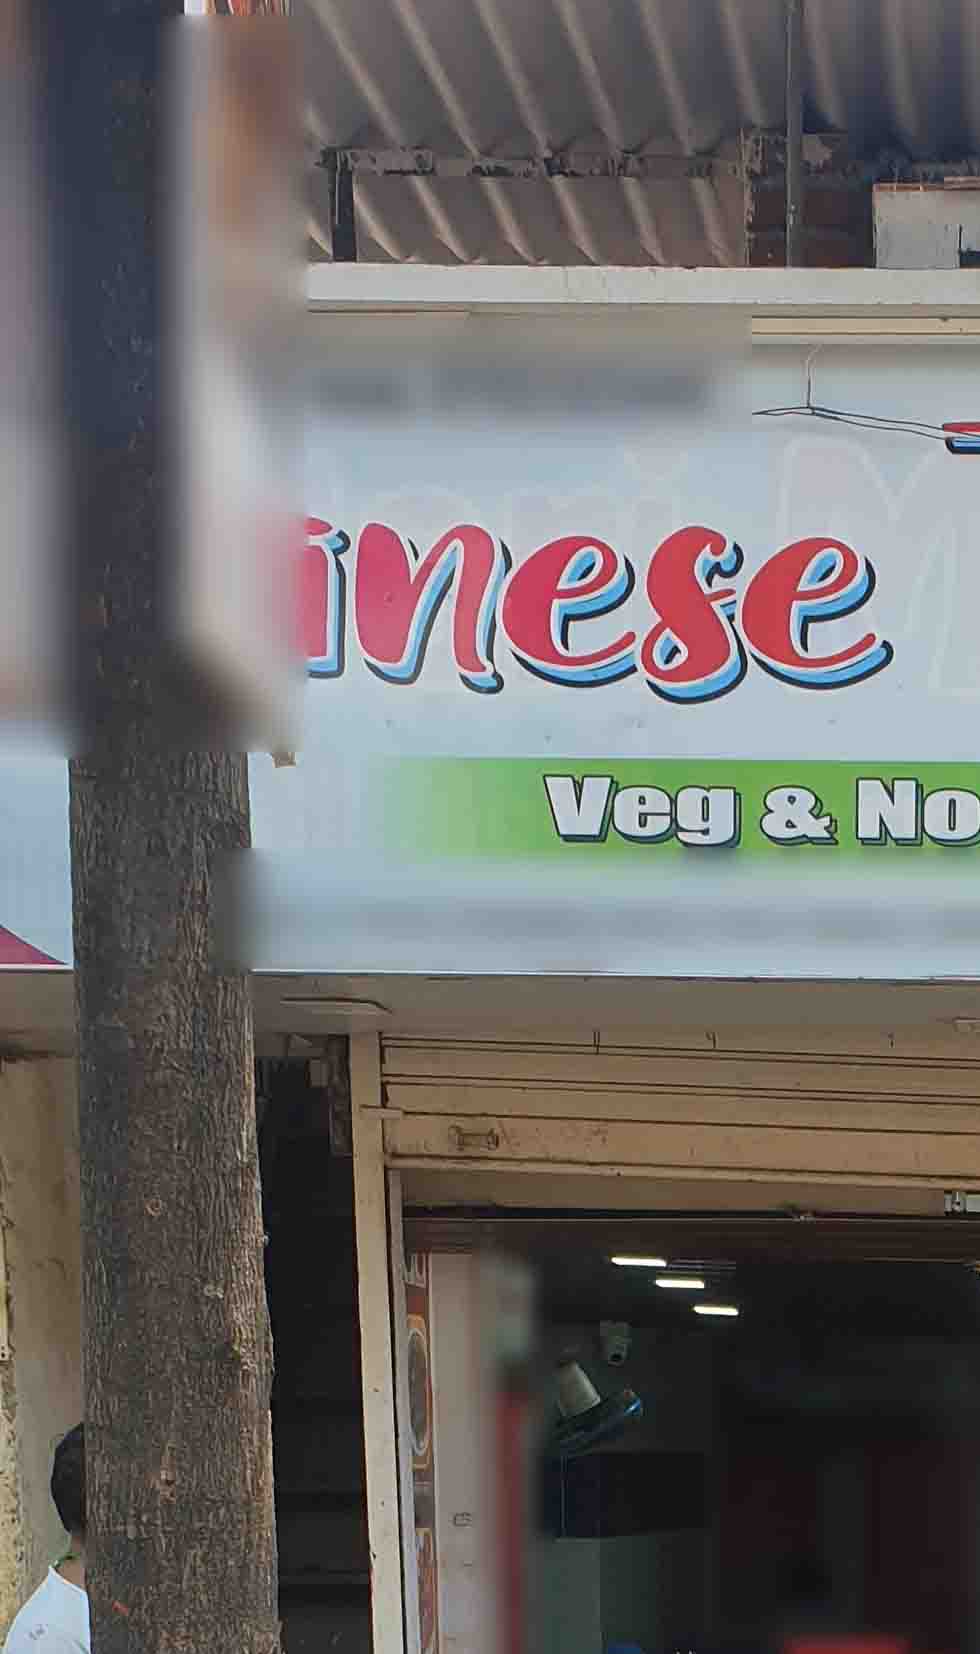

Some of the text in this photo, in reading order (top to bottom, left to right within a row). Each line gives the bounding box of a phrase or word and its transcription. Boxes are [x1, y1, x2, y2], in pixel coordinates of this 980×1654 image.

[301, 515, 893, 704] inese
[544, 775, 740, 849] Veg
[760, 785, 838, 846] &
